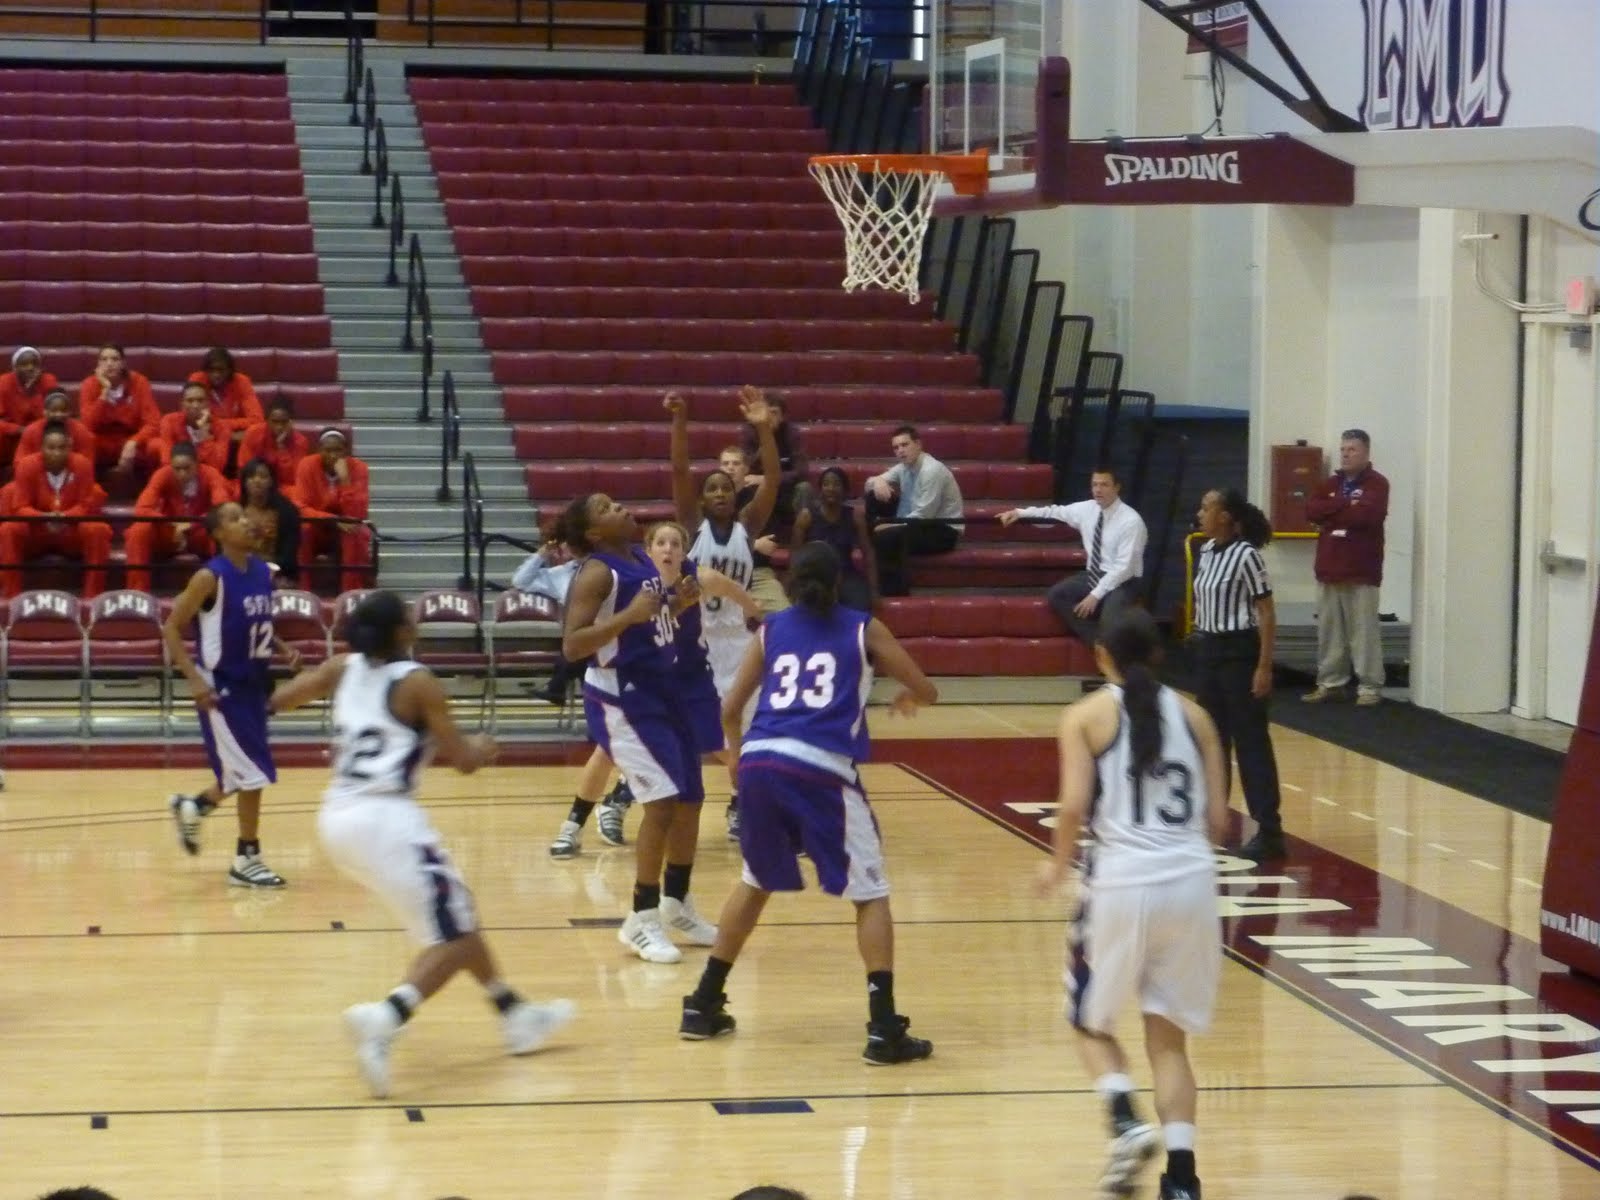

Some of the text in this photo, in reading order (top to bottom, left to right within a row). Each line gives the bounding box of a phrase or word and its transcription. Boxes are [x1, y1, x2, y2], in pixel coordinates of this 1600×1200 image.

[1360, 0, 1509, 130] LMU
[1104, 150, 1241, 186] SPALDING
[23, 594, 67, 617] LMU
[105, 594, 148, 617] LMU
[426, 594, 469, 616] LMU
[506, 593, 549, 613] LMU
[249, 620, 273, 659] 12
[769, 652, 837, 710] 33
[1126, 759, 1194, 826] 13
